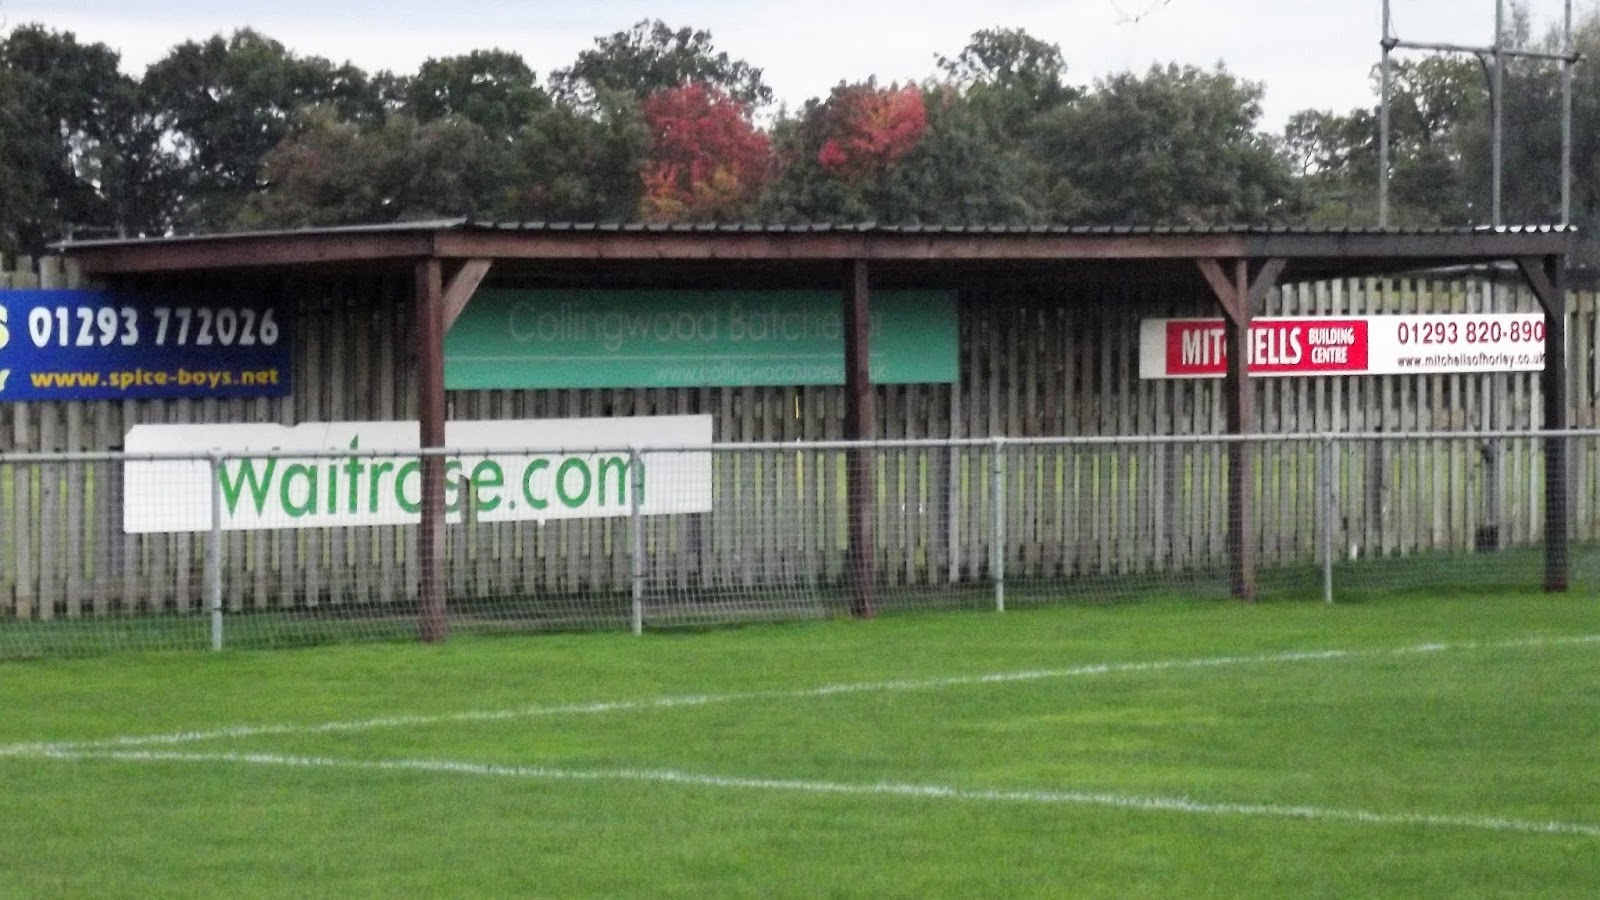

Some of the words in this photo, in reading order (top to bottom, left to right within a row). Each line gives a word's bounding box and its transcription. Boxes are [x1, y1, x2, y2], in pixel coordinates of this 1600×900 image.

[28, 306, 139, 348] 01293
[153, 307, 279, 346] 772026
[509, 301, 719, 351] Collingwood
[730, 301, 882, 341] Batcher
[1308, 327, 1355, 346] BUILDING
[1397, 321, 1458, 344] 01293
[1182, 327, 1302, 366] MITELLS
[1311, 346, 1348, 364] CENTRE
[1397, 351, 1546, 369] www.mitchellsofhorley.co.uk
[30, 368, 279, 390] www.spice-boys.net
[215, 433, 646, 520] Waitrose.com
